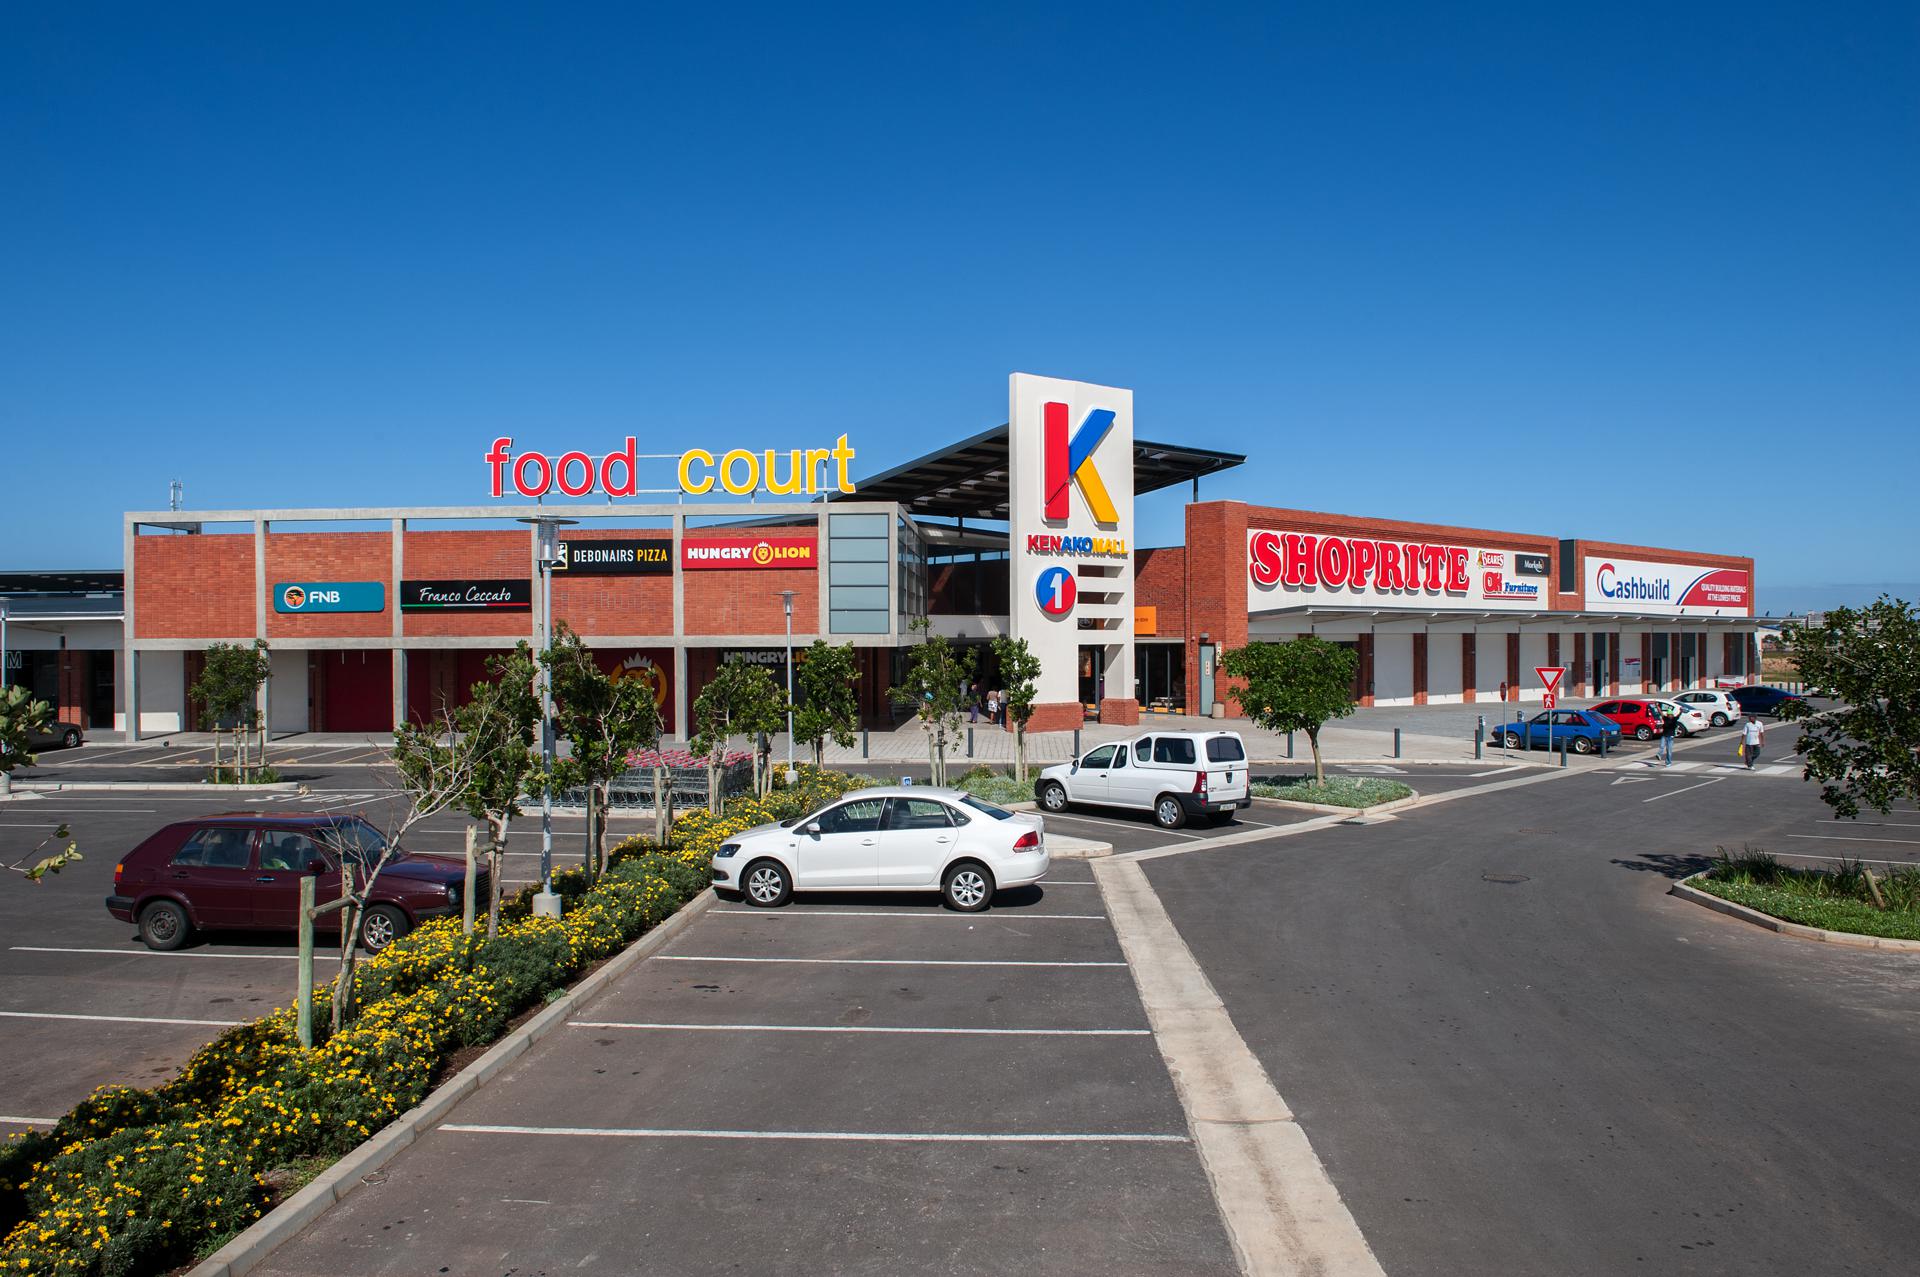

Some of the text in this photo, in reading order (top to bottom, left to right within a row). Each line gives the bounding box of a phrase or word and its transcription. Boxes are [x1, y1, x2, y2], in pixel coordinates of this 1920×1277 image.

[485, 433, 856, 497] food court
[1043, 401, 1119, 523] K
[573, 548, 668, 563] DEBONAIRS PIZZA
[687, 546, 811, 560] HUNGRY LION
[1250, 530, 1470, 591] SHOPRITE
[419, 586, 512, 602] Franco Ceccato
[1050, 572, 1063, 609] 1
[1505, 581, 1539, 594] Furniture
[1597, 562, 1670, 601] Cashbuild
[309, 591, 341, 604] FNB
